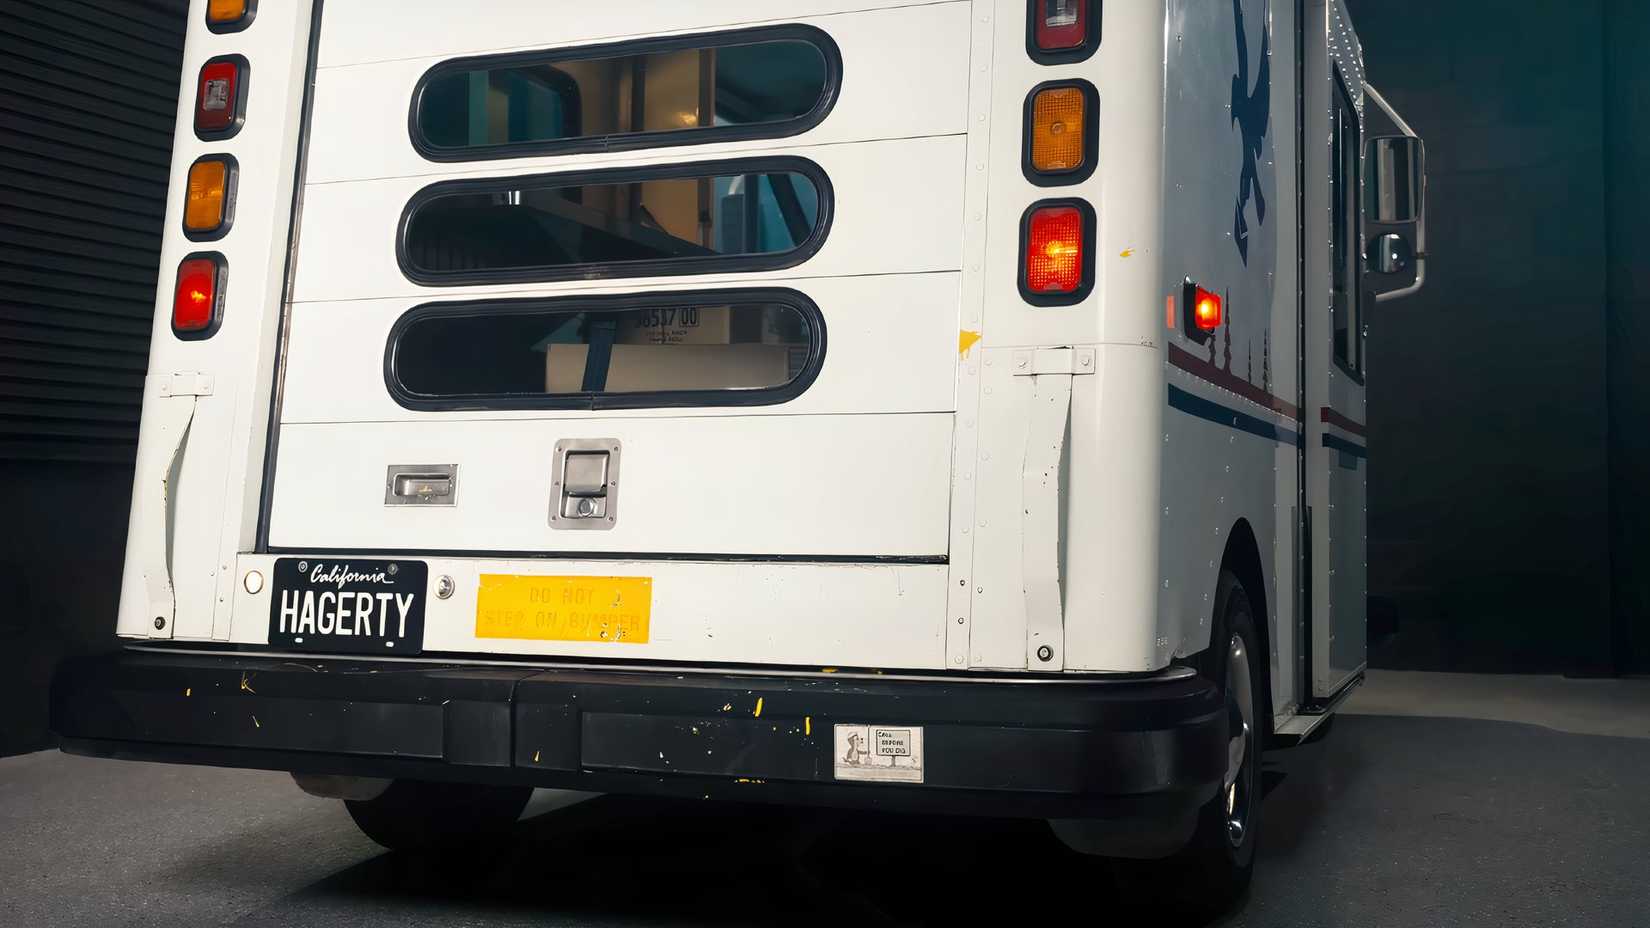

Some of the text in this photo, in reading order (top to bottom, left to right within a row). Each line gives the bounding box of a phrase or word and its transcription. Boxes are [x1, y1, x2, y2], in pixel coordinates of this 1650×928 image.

[310, 563, 395, 590] California
[529, 586, 595, 607] DO NOT
[279, 589, 415, 638] HAGERTY
[535, 609, 558, 629] ON
